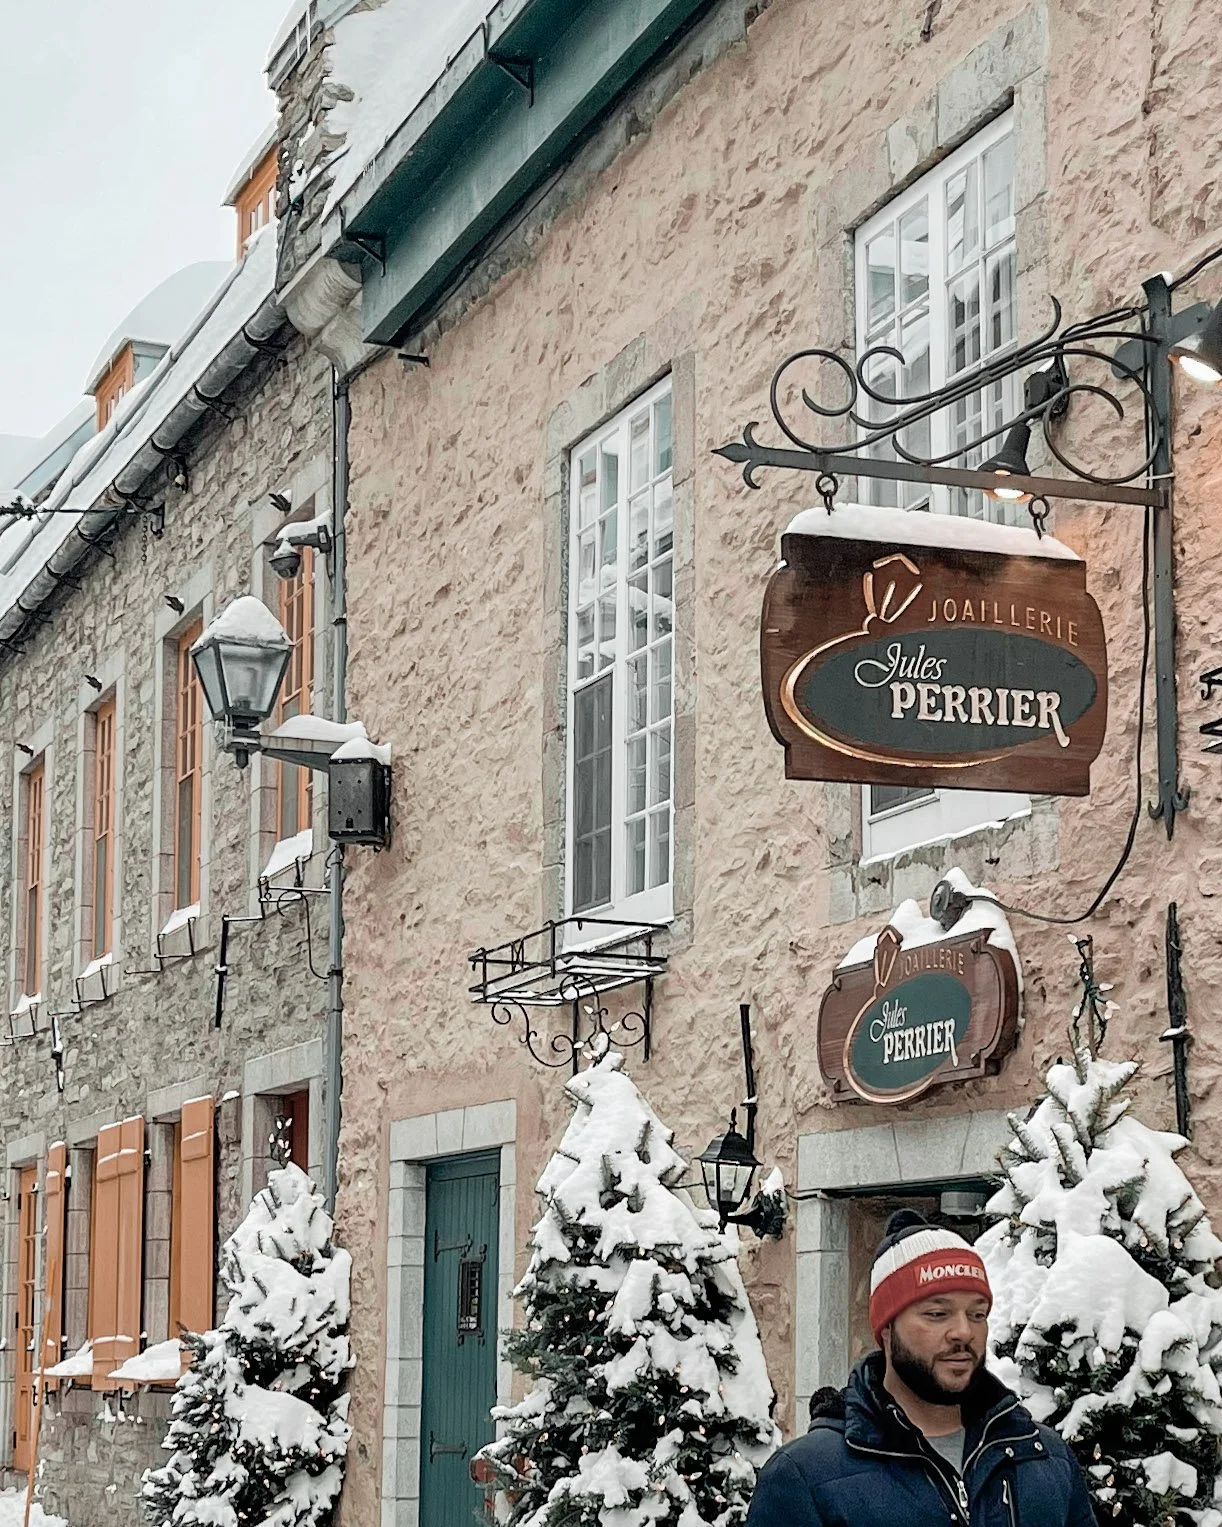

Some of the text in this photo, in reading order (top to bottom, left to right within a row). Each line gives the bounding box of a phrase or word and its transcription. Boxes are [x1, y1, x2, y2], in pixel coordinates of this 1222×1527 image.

[927, 598, 1079, 647] JOAILLERIE
[854, 642, 948, 688] Jules
[889, 681, 1071, 748] PERRIER
[899, 948, 964, 979] JOAILLERIE
[870, 999, 908, 1042] Jules
[883, 1018, 959, 1067] PERRIER
